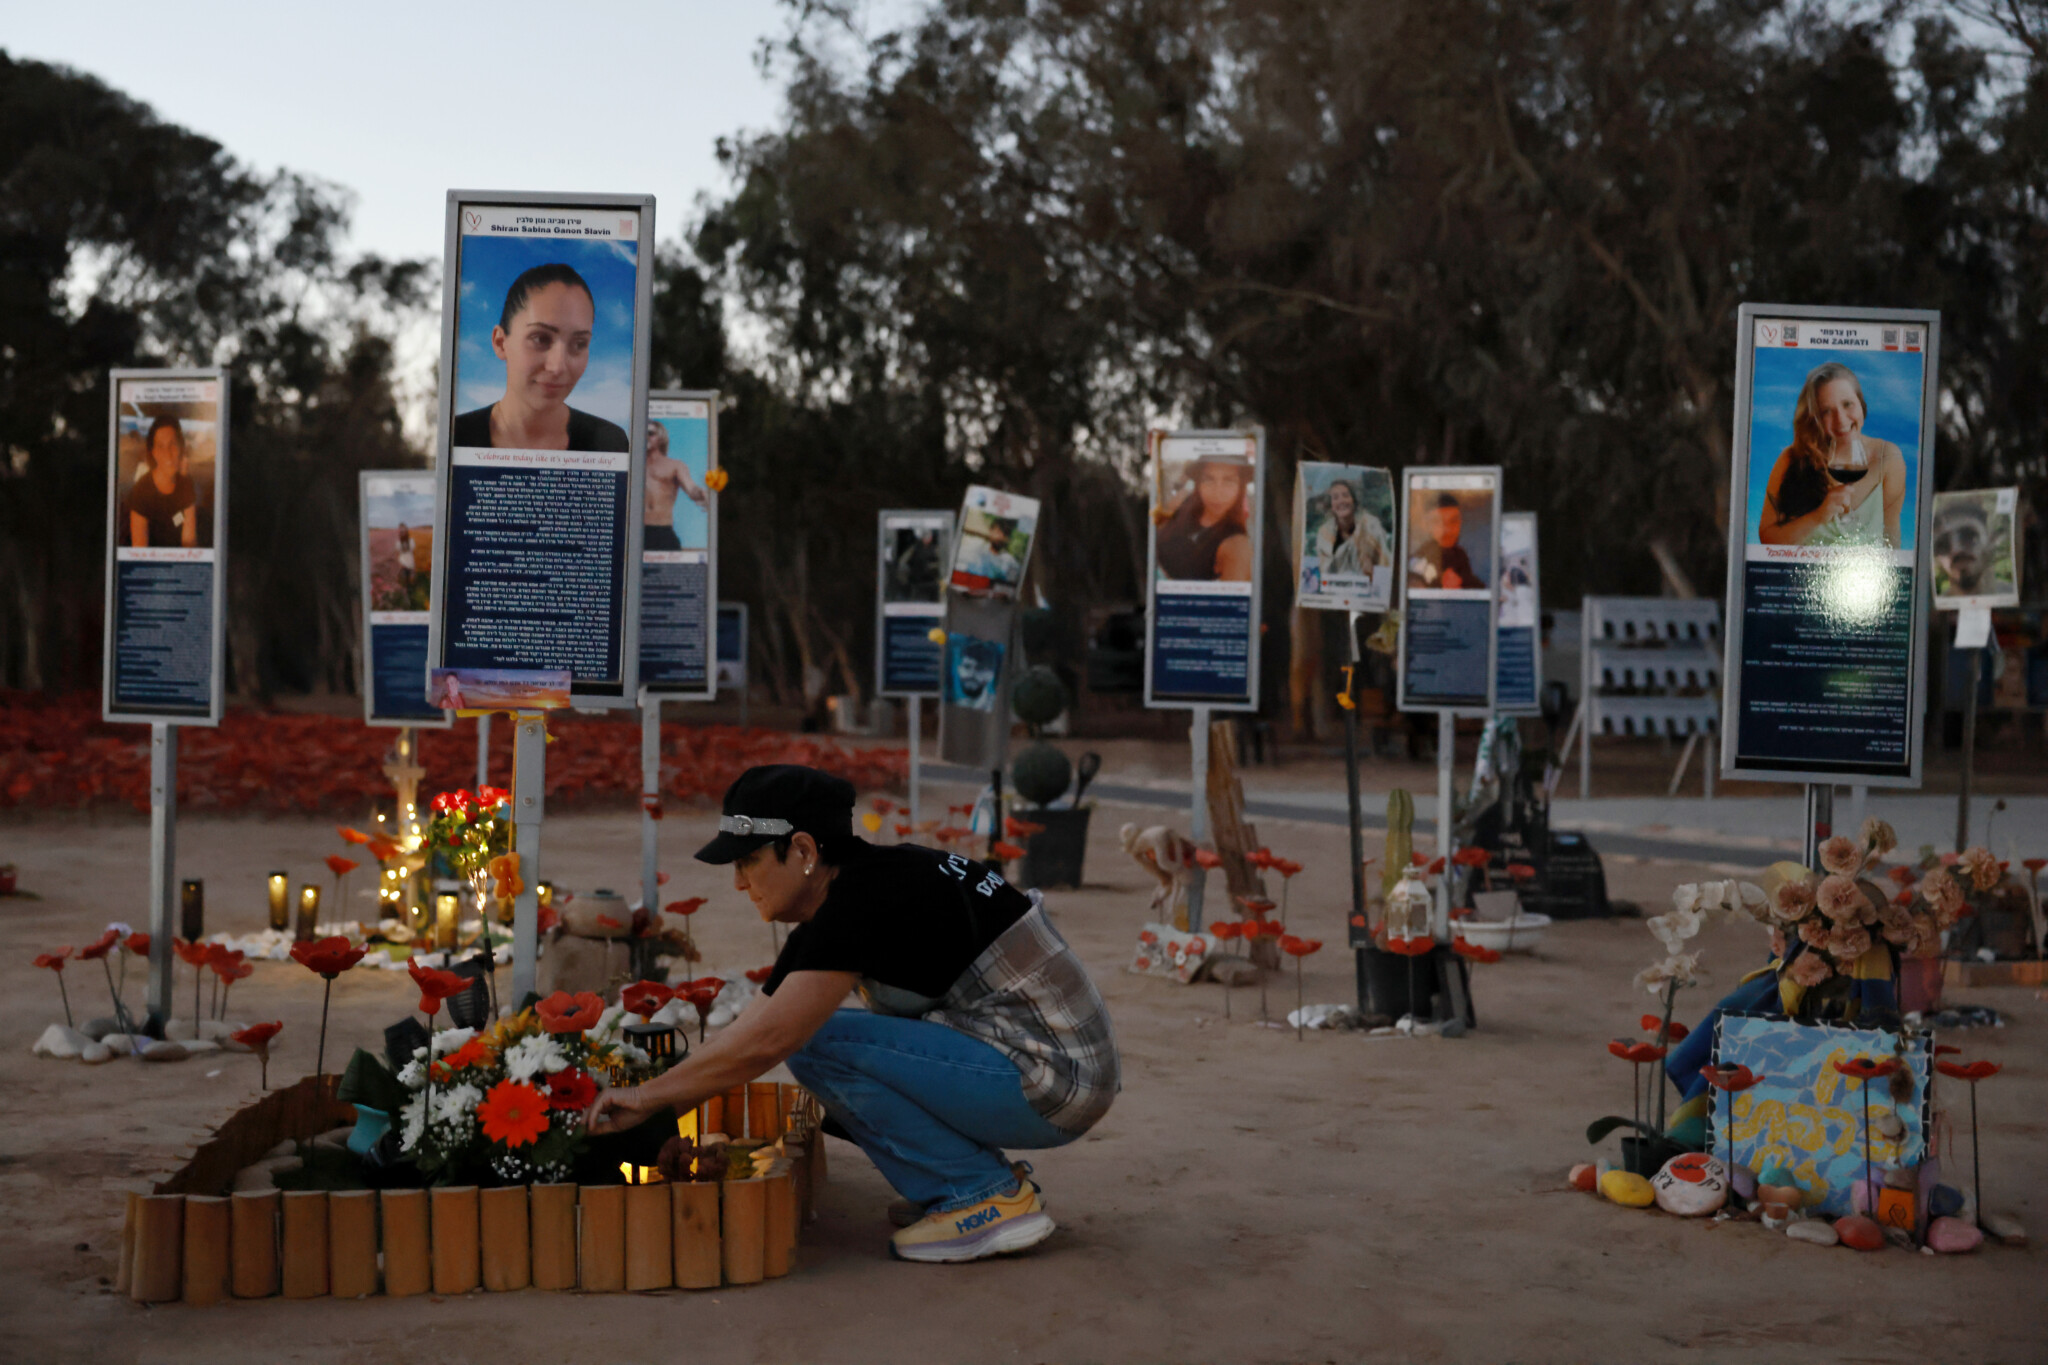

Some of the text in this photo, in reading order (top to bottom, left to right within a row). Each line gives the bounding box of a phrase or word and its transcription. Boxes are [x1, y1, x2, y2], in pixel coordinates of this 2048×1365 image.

[491, 224, 611, 236] Shiran Sabina Ganon Slavin
[1846, 329, 1857, 337] רון
[1810, 337, 1869, 346] RON ZARFATI
[513, 454, 533, 464] today
[535, 454, 548, 462] like
[563, 456, 581, 465] your
[582, 456, 596, 464] last
[955, 1205, 1002, 1235] HOKA
